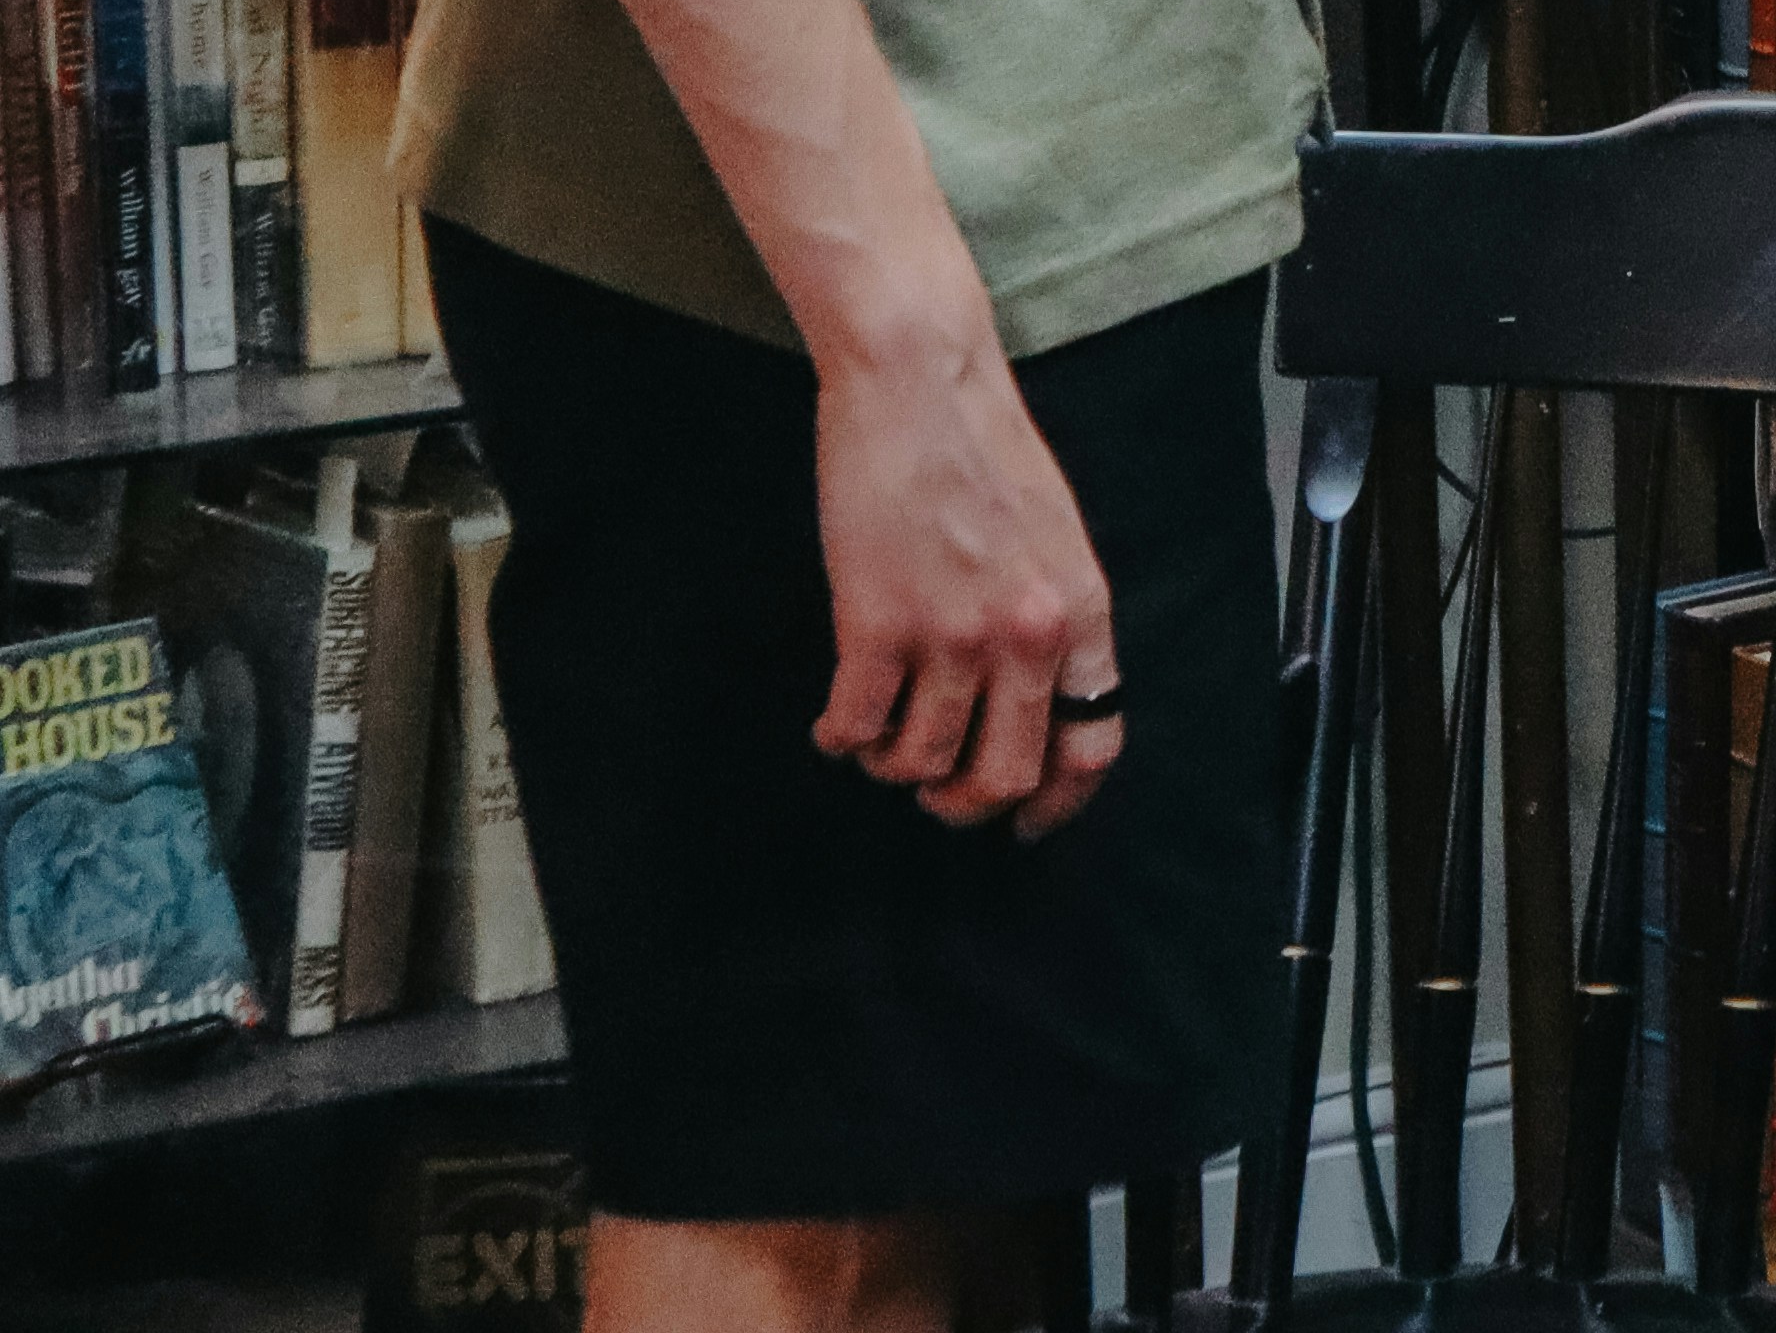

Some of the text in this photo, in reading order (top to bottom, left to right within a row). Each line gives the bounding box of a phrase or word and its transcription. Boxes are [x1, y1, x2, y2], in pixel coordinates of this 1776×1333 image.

[189, 0, 212, 69] home
[0, 635, 152, 720] OOKED
[2, 692, 177, 777] HOUSE
